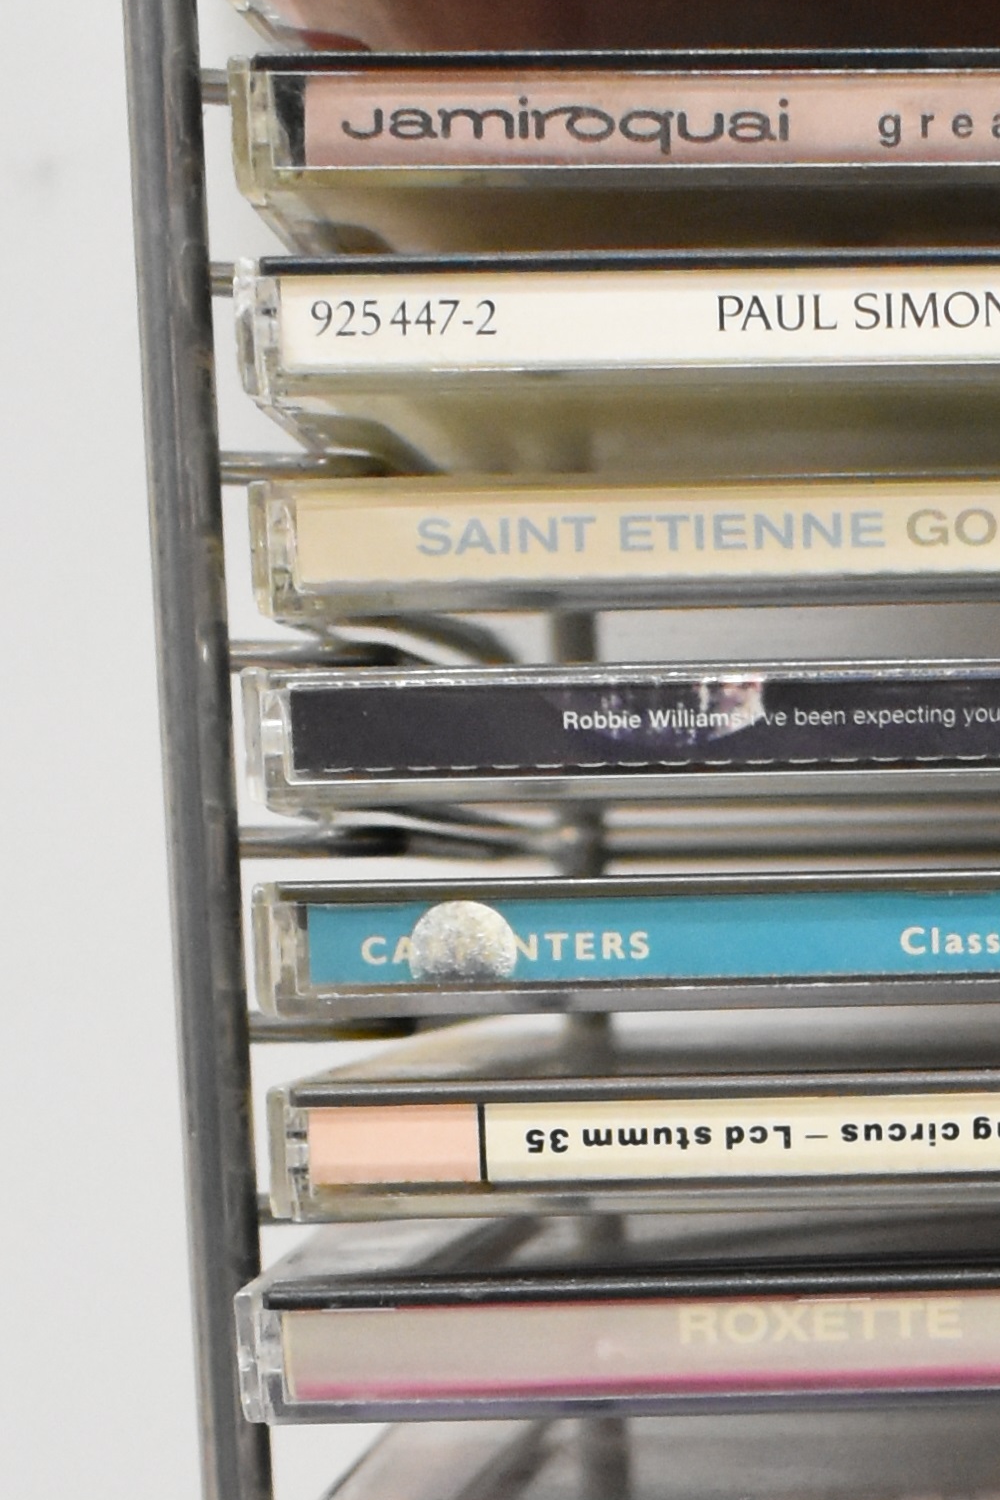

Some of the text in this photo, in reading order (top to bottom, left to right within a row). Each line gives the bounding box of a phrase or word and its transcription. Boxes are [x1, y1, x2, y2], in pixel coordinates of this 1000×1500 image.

[716, 294, 837, 332] PAUL
[416, 514, 597, 556] SAINT
[619, 509, 885, 552] ETIENNE
[562, 709, 642, 731] Robbie
[648, 707, 741, 731] Williams
[794, 707, 846, 728] been
[853, 705, 957, 732] expecting
[526, 1129, 569, 1153] 35
[582, 1126, 714, 1150] stumm
[840, 1122, 962, 1146] circus
[679, 1302, 963, 1346] ROXETTE
